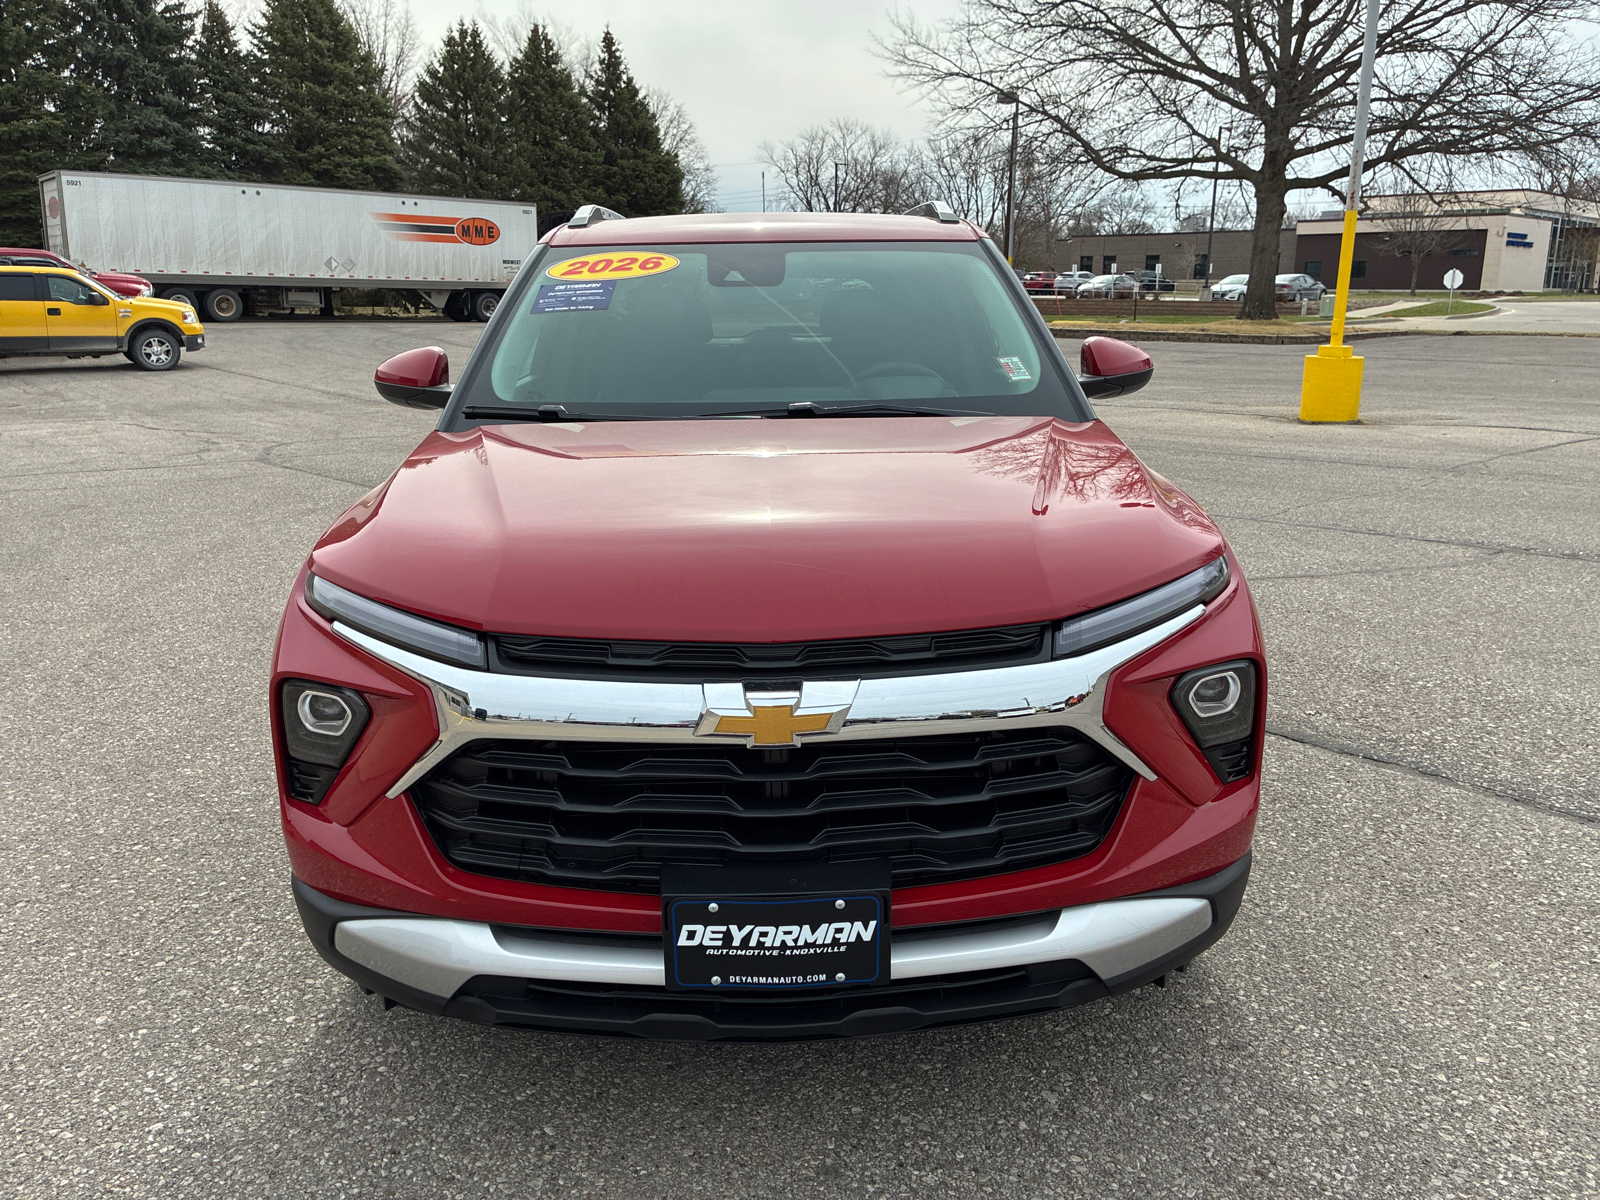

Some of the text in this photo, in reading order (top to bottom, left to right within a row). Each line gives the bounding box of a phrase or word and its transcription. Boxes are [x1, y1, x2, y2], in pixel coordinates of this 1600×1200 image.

[559, 256, 666, 277] 2026
[677, 920, 877, 947] DEYARMAN
[729, 973, 827, 984] DEYARMANAUTO.COM
